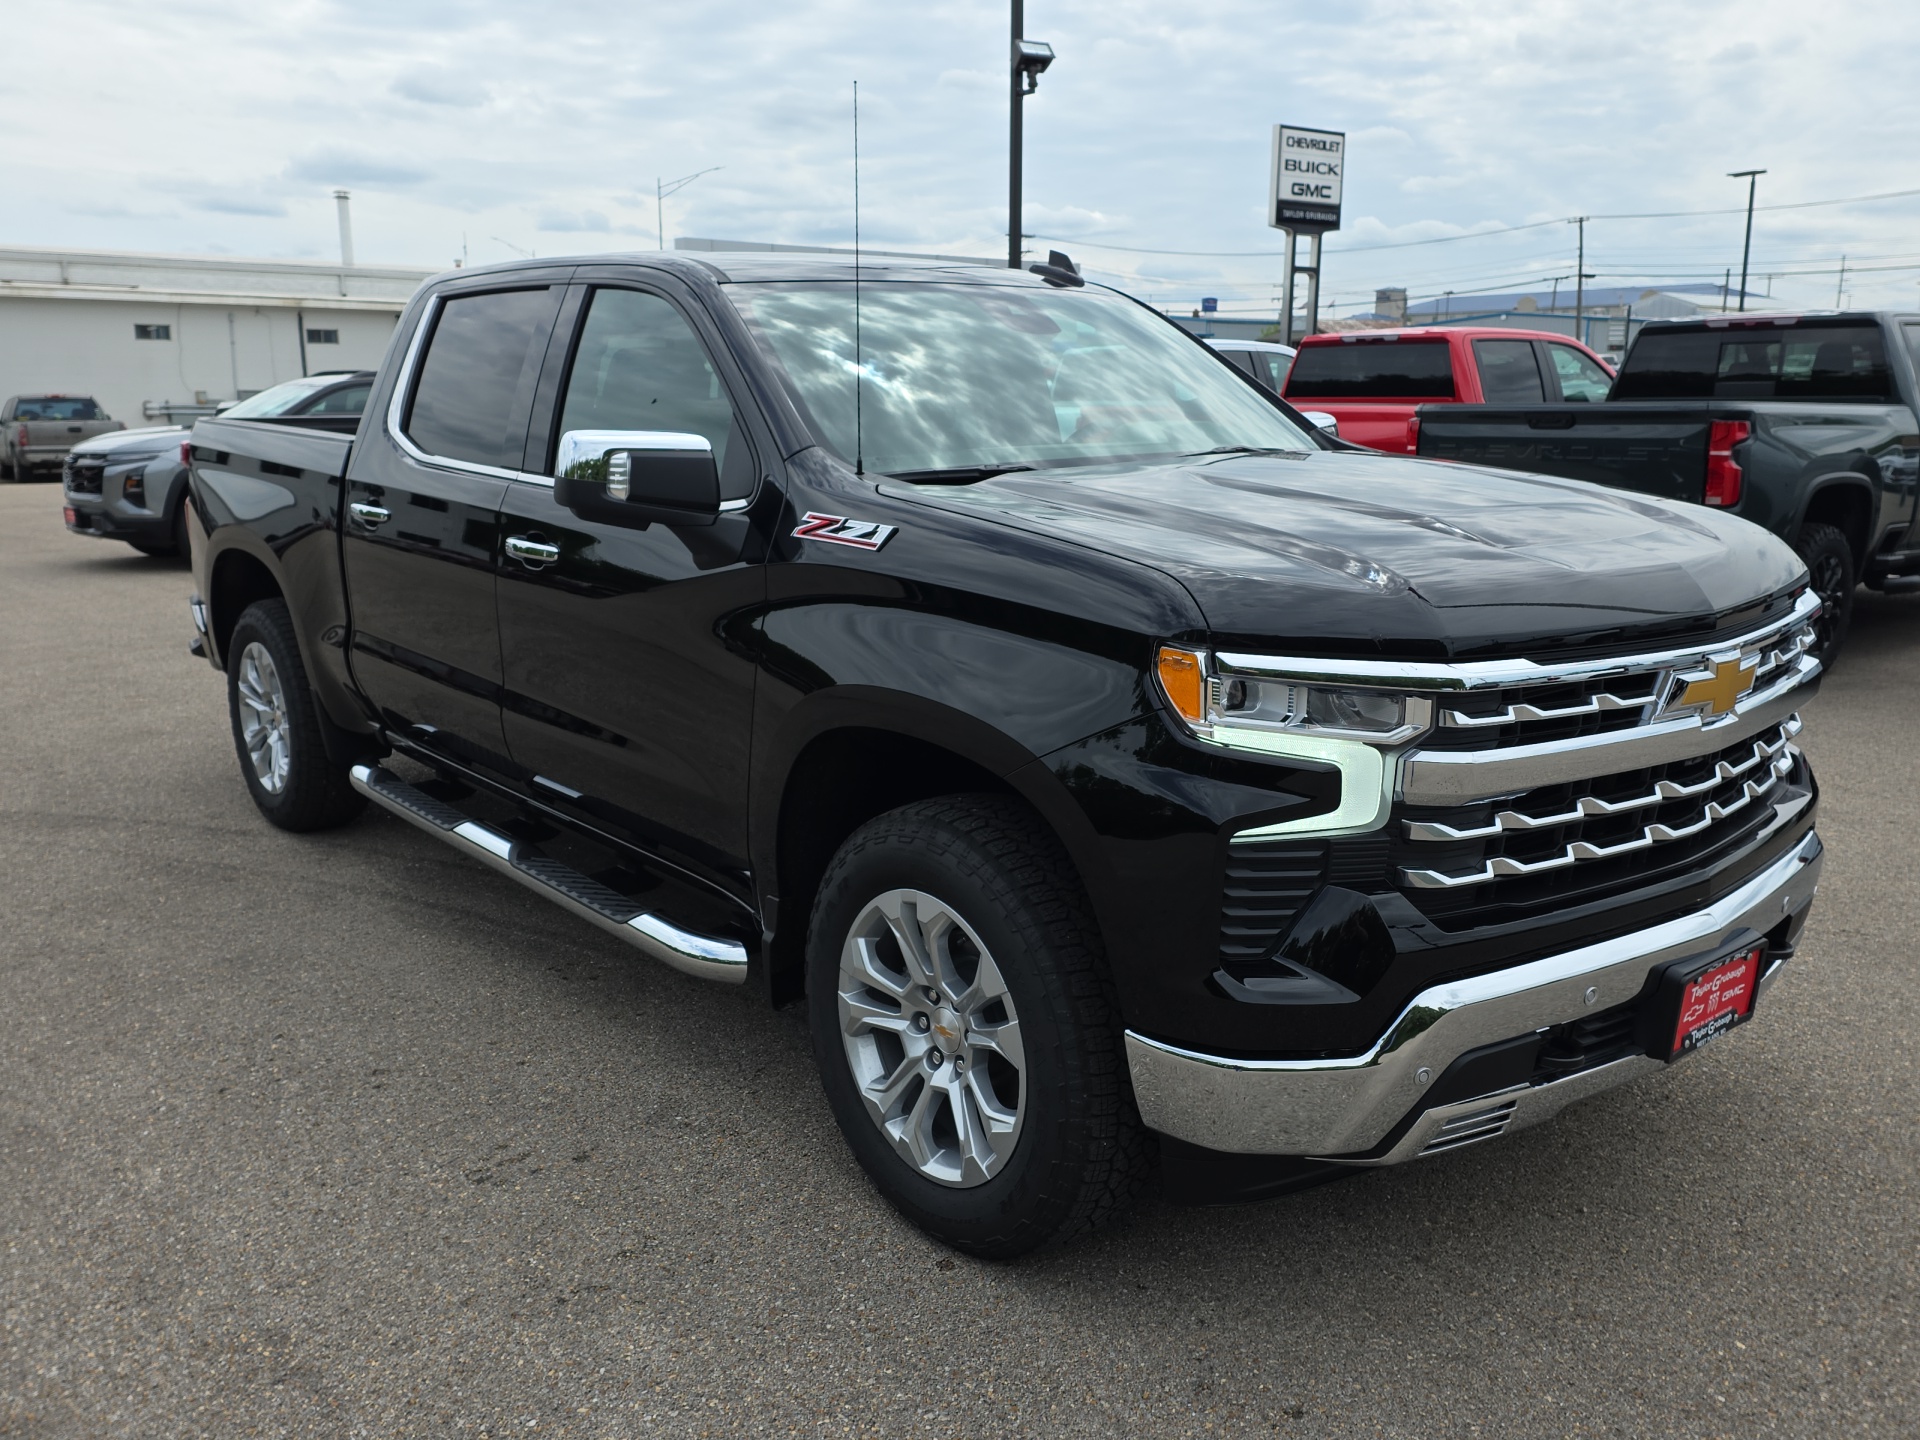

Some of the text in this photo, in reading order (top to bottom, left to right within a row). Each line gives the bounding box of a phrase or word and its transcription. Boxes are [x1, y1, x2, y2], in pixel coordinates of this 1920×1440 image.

[1286, 136, 1341, 153] CHEVROLET
[1284, 158, 1340, 176] BUICK
[1291, 182, 1332, 199] GMC
[1283, 209, 1304, 219] TAYLOR
[790, 511, 900, 552] Z71
[1691, 964, 1746, 1003] Taylor Grubaugh
[1721, 984, 1745, 1001] GMC
